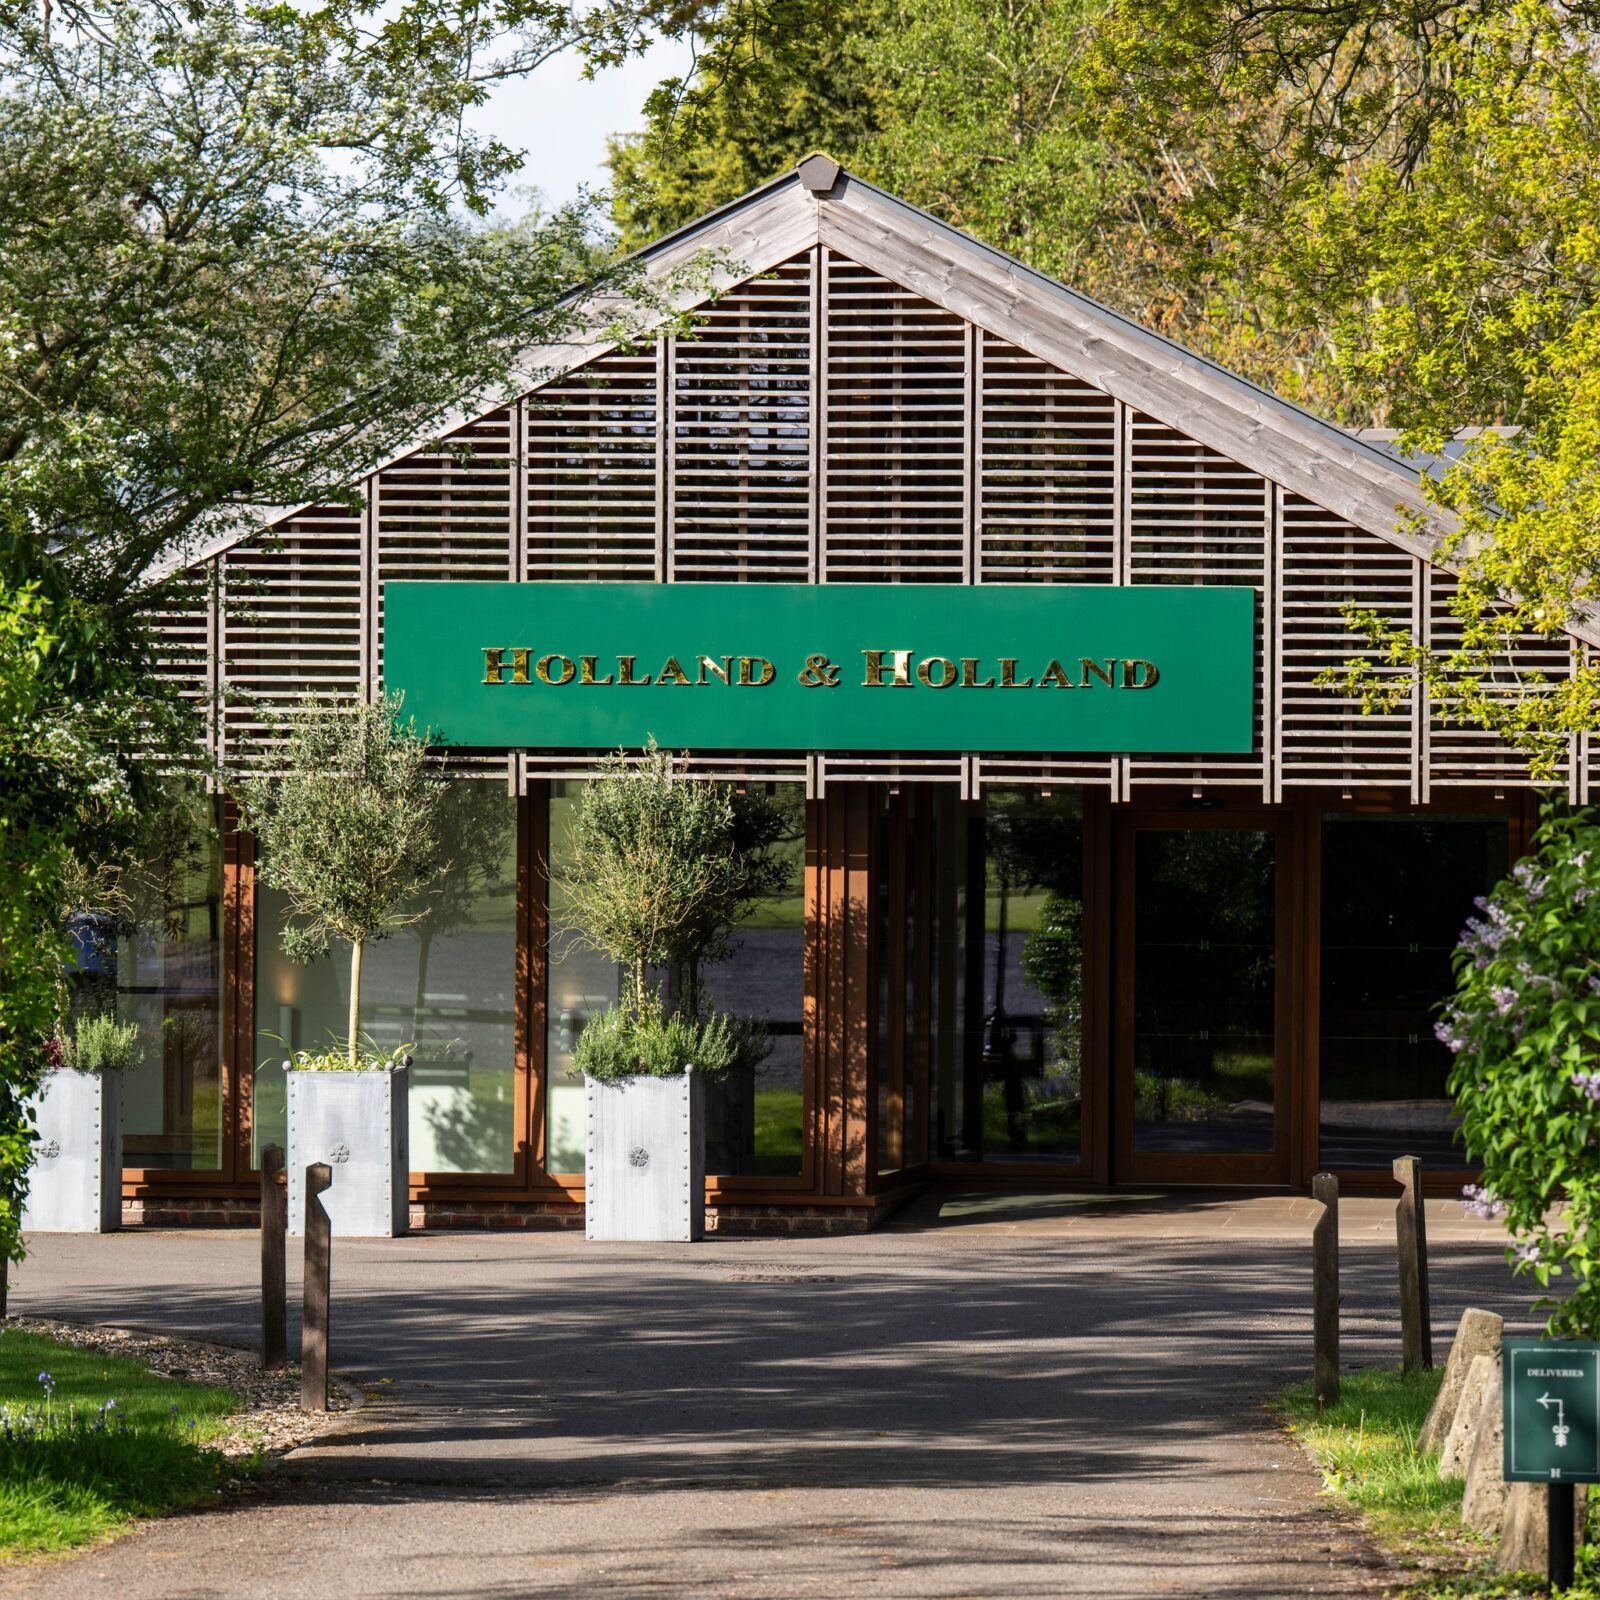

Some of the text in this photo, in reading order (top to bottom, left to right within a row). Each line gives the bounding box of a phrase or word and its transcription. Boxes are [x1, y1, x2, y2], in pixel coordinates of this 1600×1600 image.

[480, 647, 1160, 688] HOLLAND & HOLLAND
[1527, 1368, 1584, 1377] DELIVERIES
